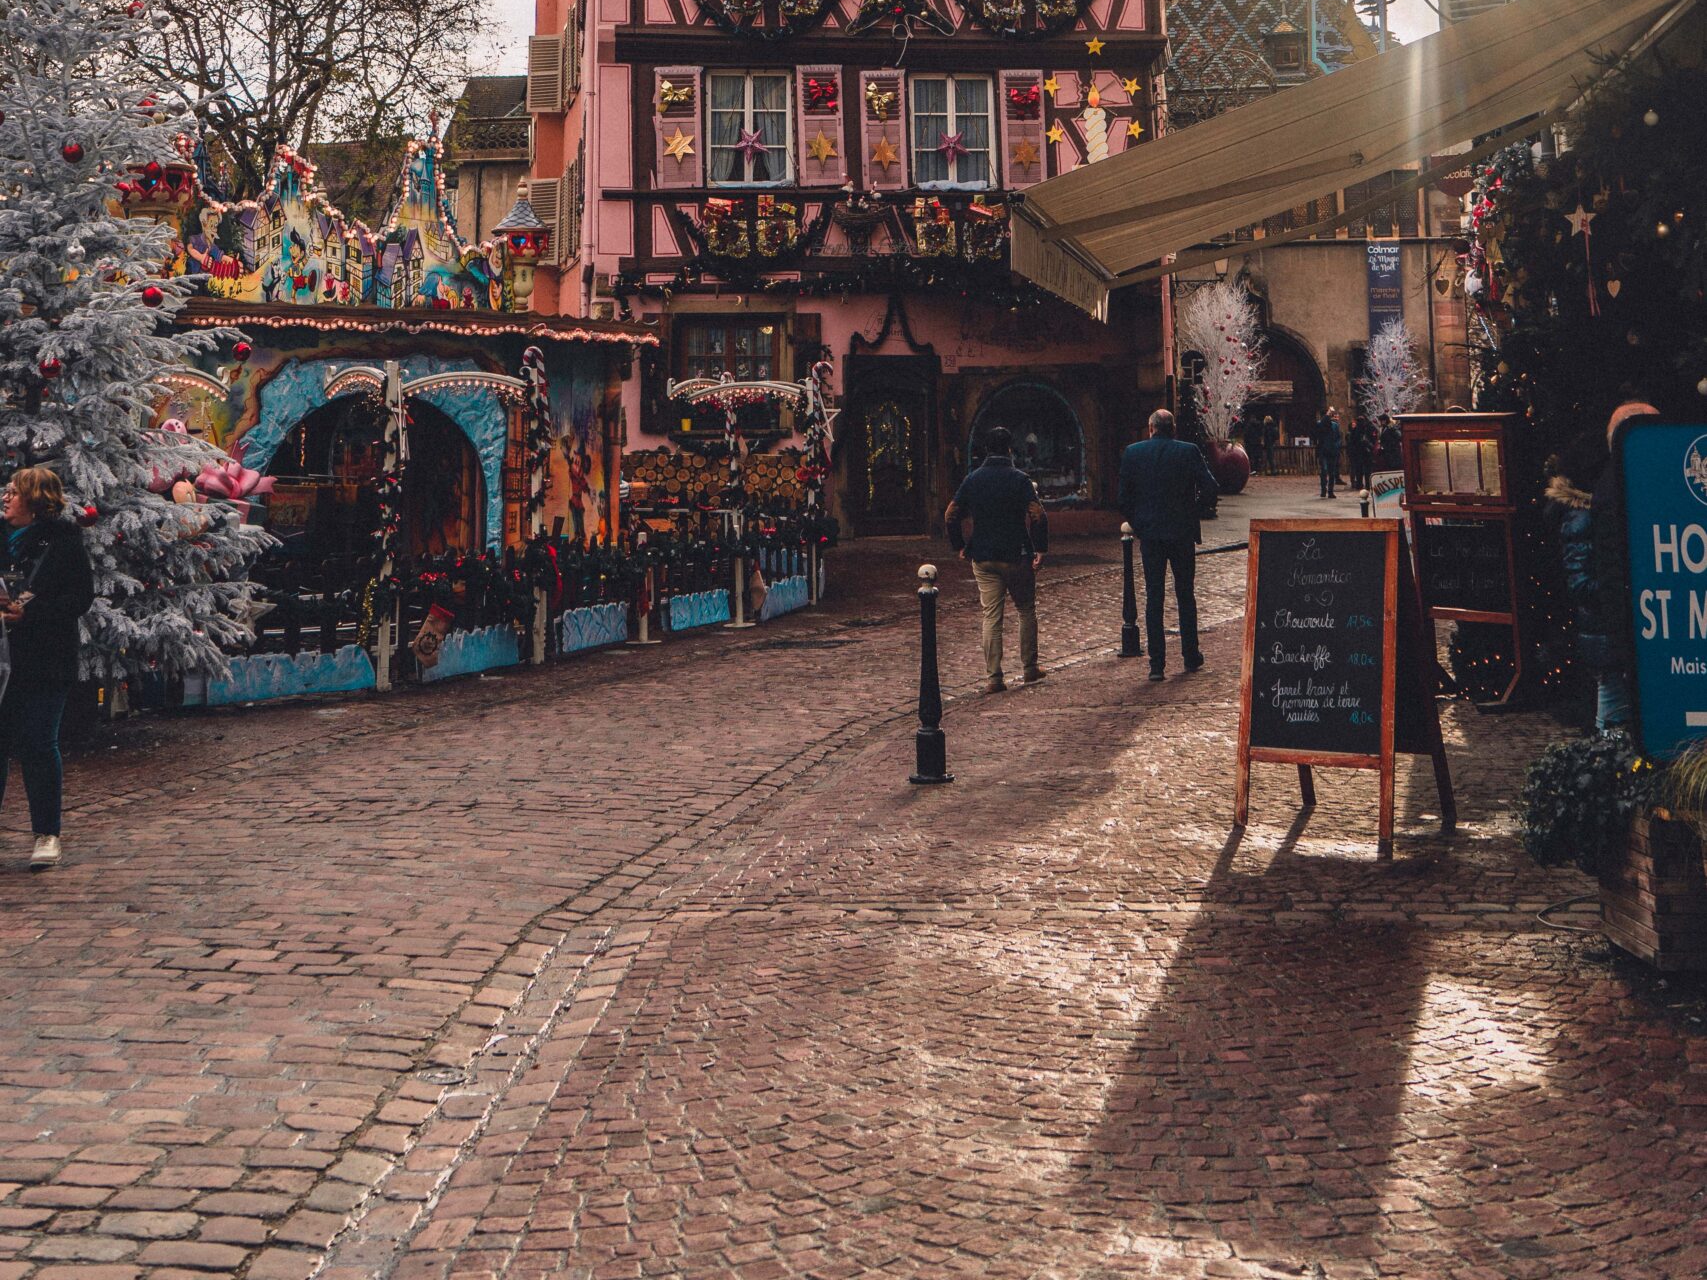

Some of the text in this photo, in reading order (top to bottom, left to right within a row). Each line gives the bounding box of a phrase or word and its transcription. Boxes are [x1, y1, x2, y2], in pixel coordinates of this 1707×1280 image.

[1367, 245, 1400, 254] Colmar
[1373, 480, 1391, 497] NOS
[1297, 538, 1323, 560] La
[1653, 524, 1707, 574] HO
[1274, 608, 1335, 629] Choucroute
[1640, 589, 1671, 640] ST
[1671, 656, 1707, 675] Mais
[1271, 677, 1302, 708] Jarret
[1340, 680, 1351, 696] et
[1281, 695, 1361, 716] pommes de terre
